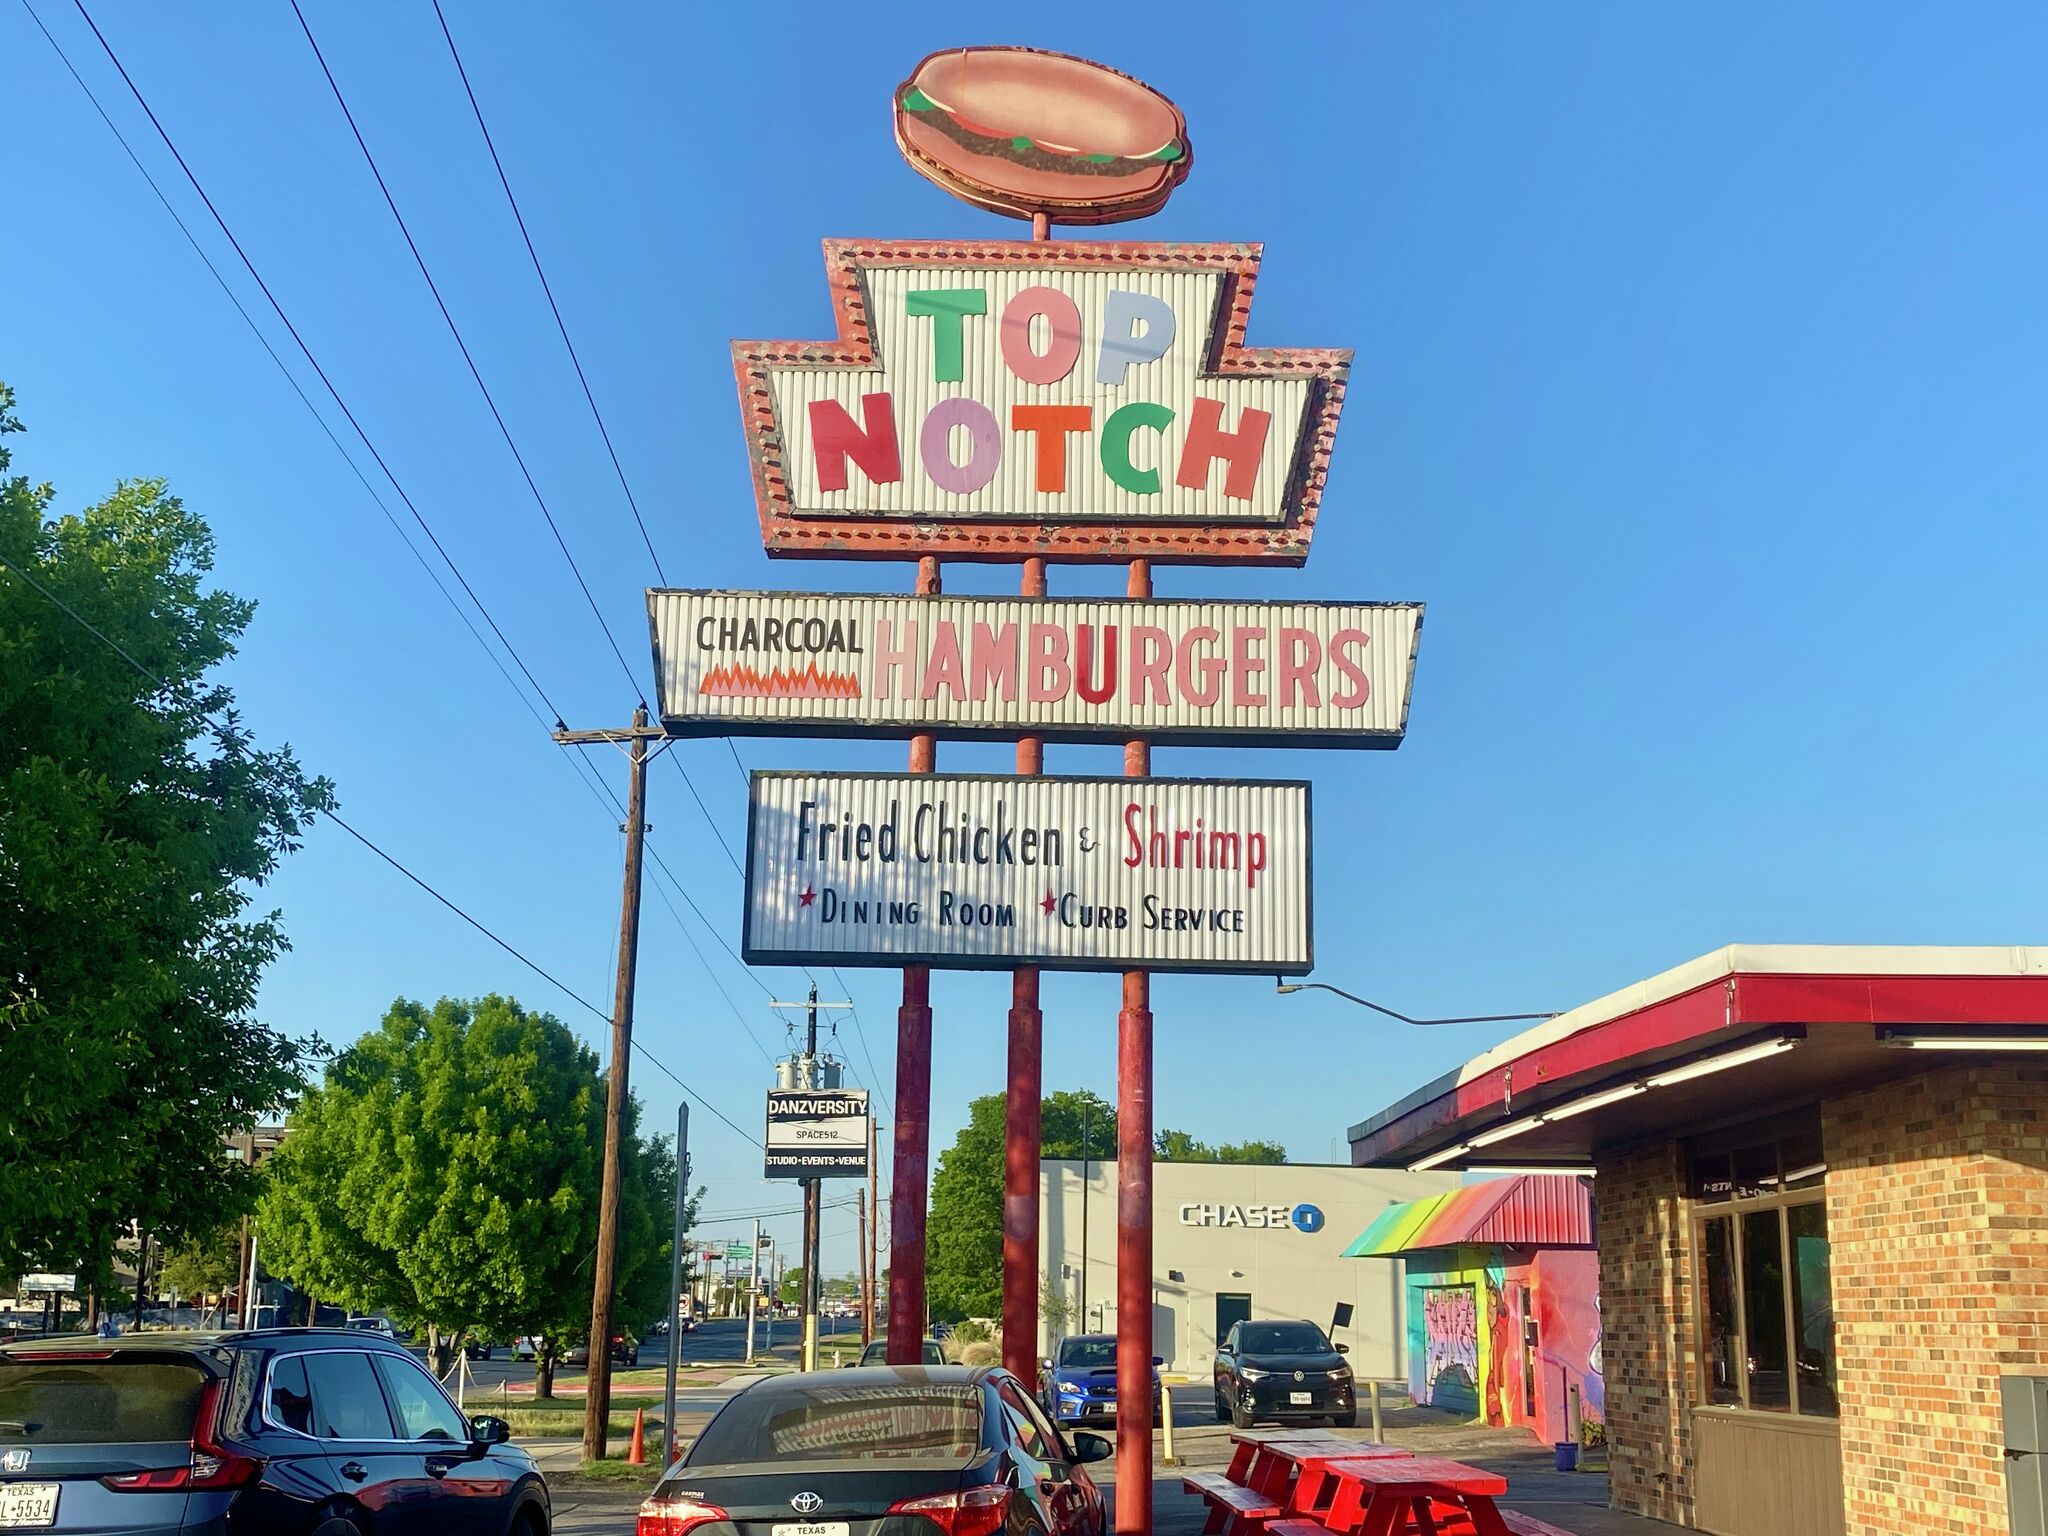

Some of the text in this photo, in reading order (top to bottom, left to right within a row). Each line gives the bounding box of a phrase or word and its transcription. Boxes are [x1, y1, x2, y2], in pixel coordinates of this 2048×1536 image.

[906, 286, 1176, 386] TOP
[808, 392, 1271, 500] NOTCH
[697, 617, 864, 653] CHARCOAL
[874, 619, 1371, 709] HAMBURGERS
[797, 800, 898, 862] Fried
[914, 801, 1063, 866] Chicken
[1124, 804, 1267, 888] Shrimp
[821, 888, 1014, 927] DINING ROOM
[1060, 892, 1244, 933] CURB SERVICE
[768, 1100, 867, 1114] DANZVERSITY
[796, 1130, 838, 1139] SPACE512
[1178, 1203, 1290, 1229] CHASE
[7, 1487, 35, 1496] TEXAS
[797, 1526, 826, 1534] TEXAS
